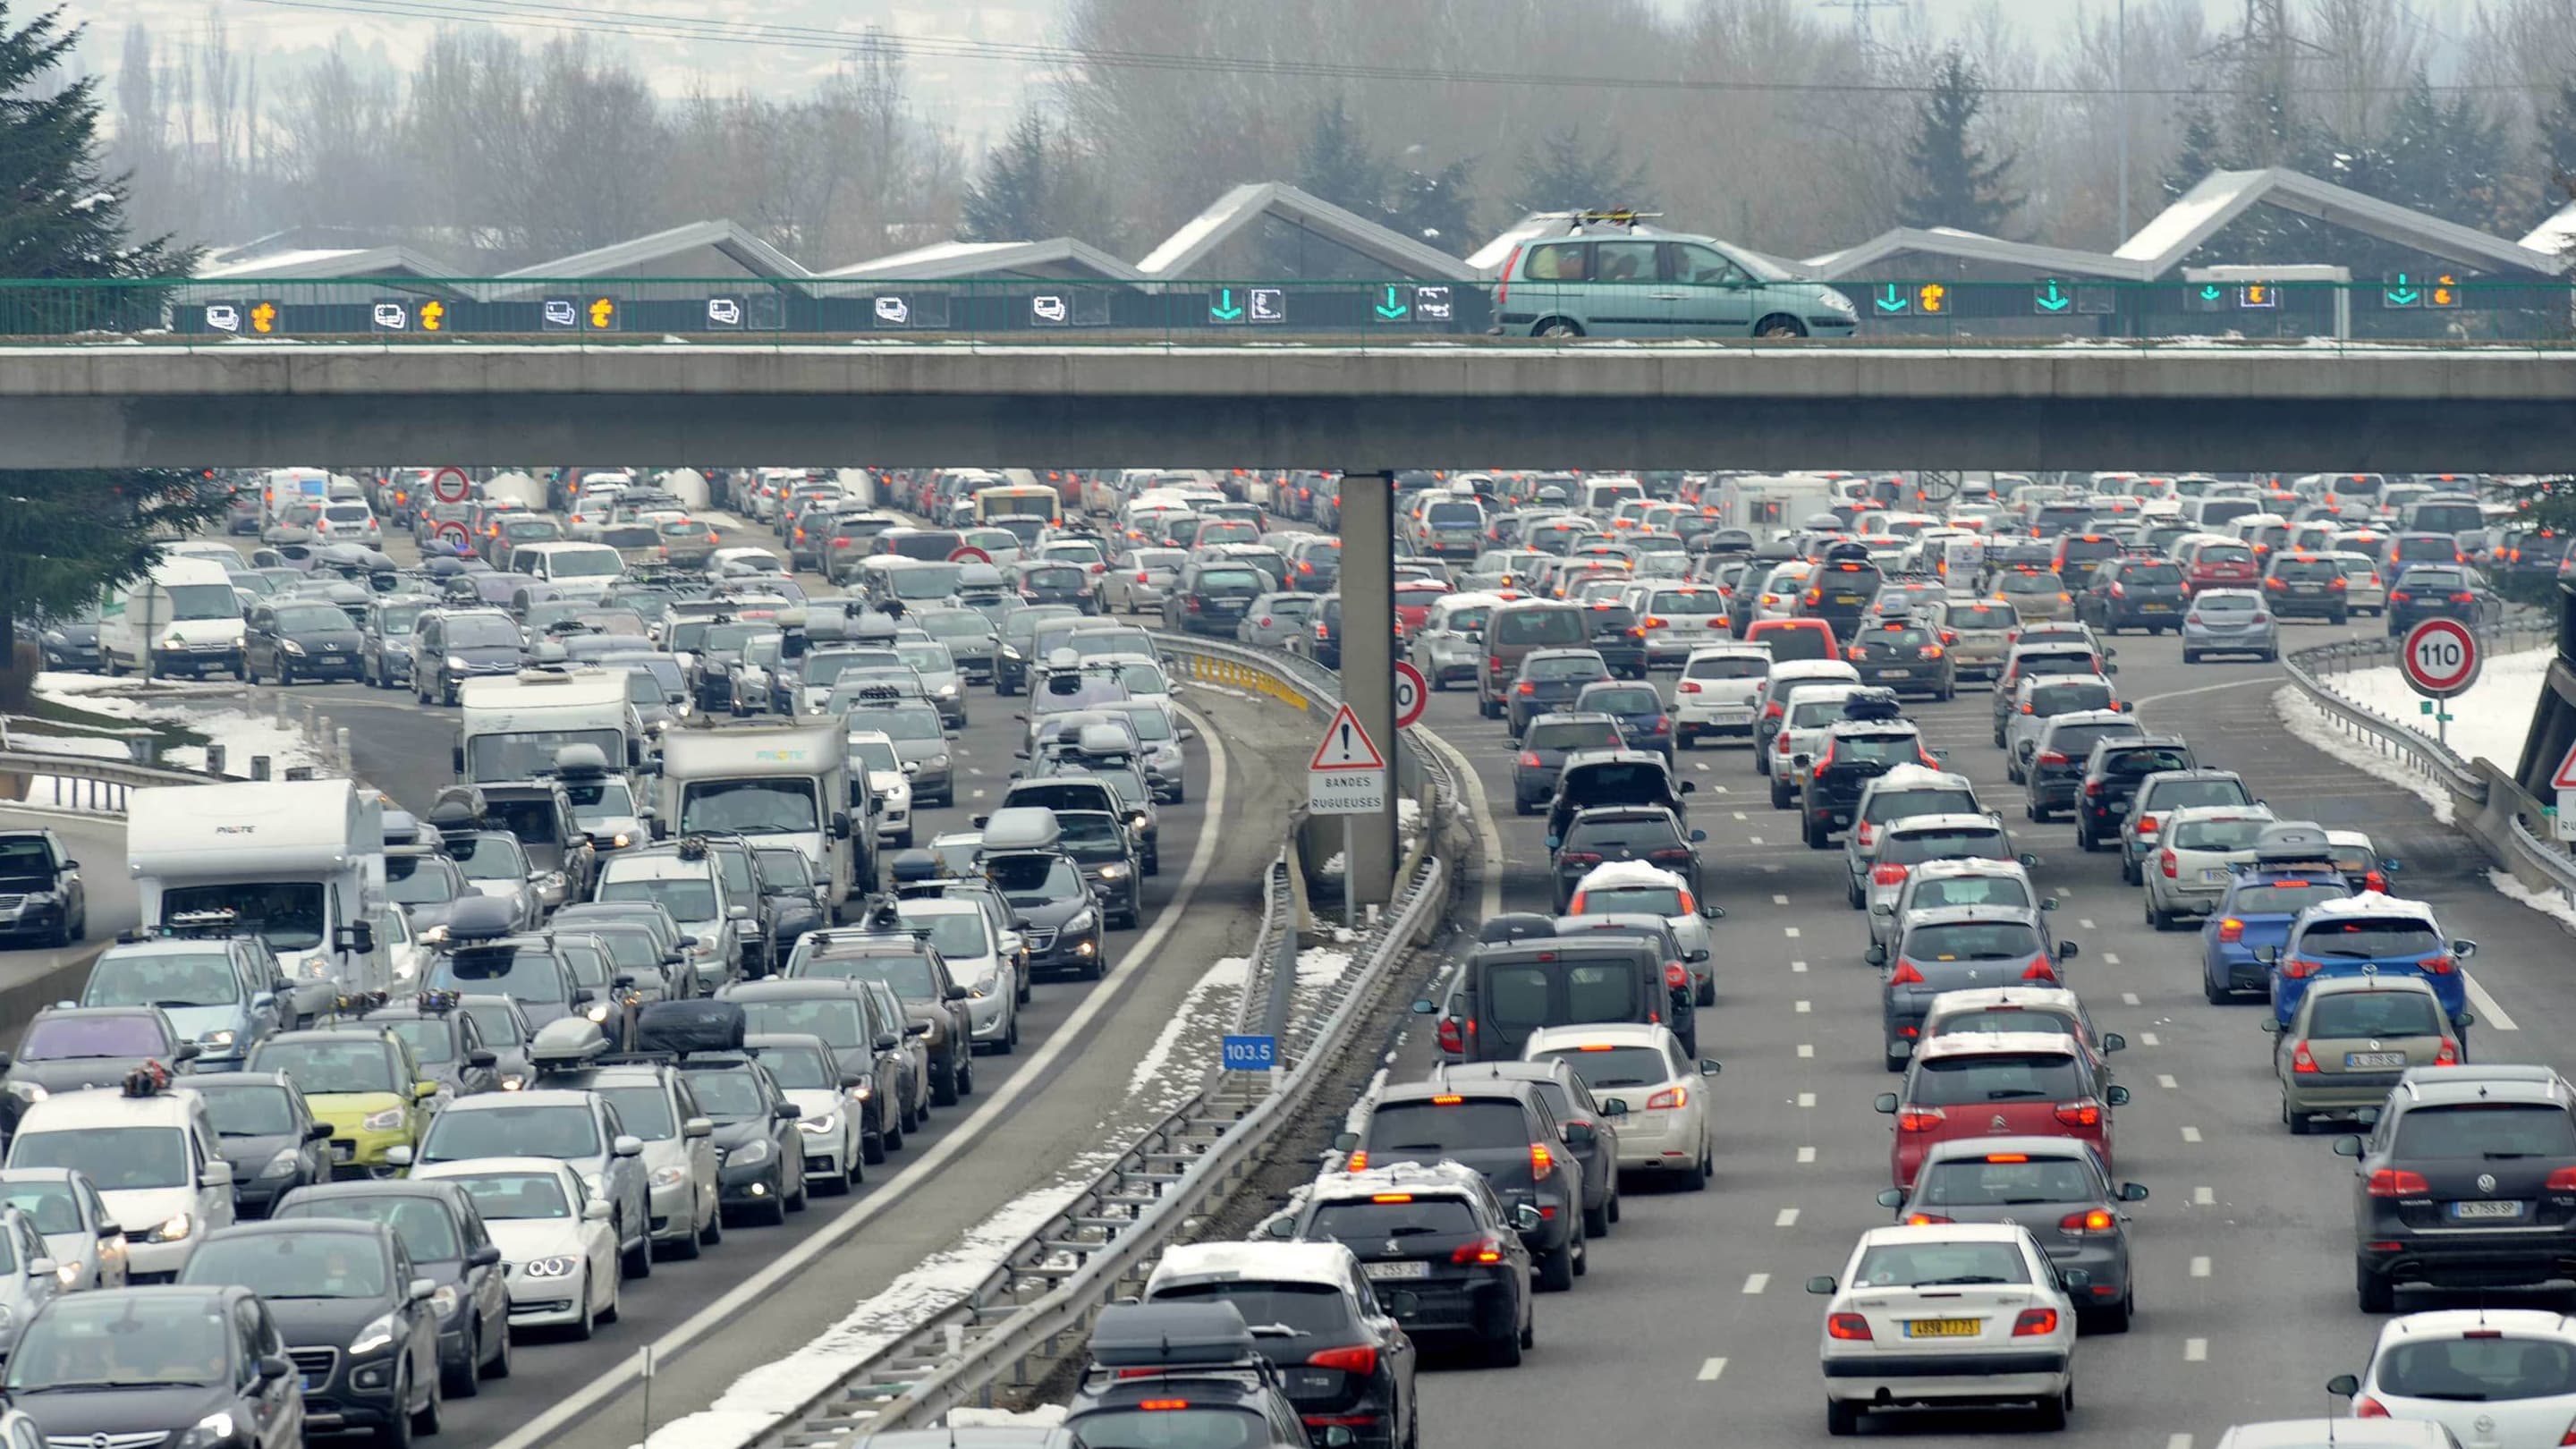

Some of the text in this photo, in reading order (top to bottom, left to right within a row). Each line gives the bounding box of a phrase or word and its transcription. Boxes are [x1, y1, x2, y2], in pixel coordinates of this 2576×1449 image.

[2419, 643, 2460, 665] 110
[1397, 684, 1413, 706] 0
[1325, 775, 1371, 788] BANDES
[1311, 796, 1382, 809] RUGUEUSES
[1225, 1044, 1271, 1061] 103.5
